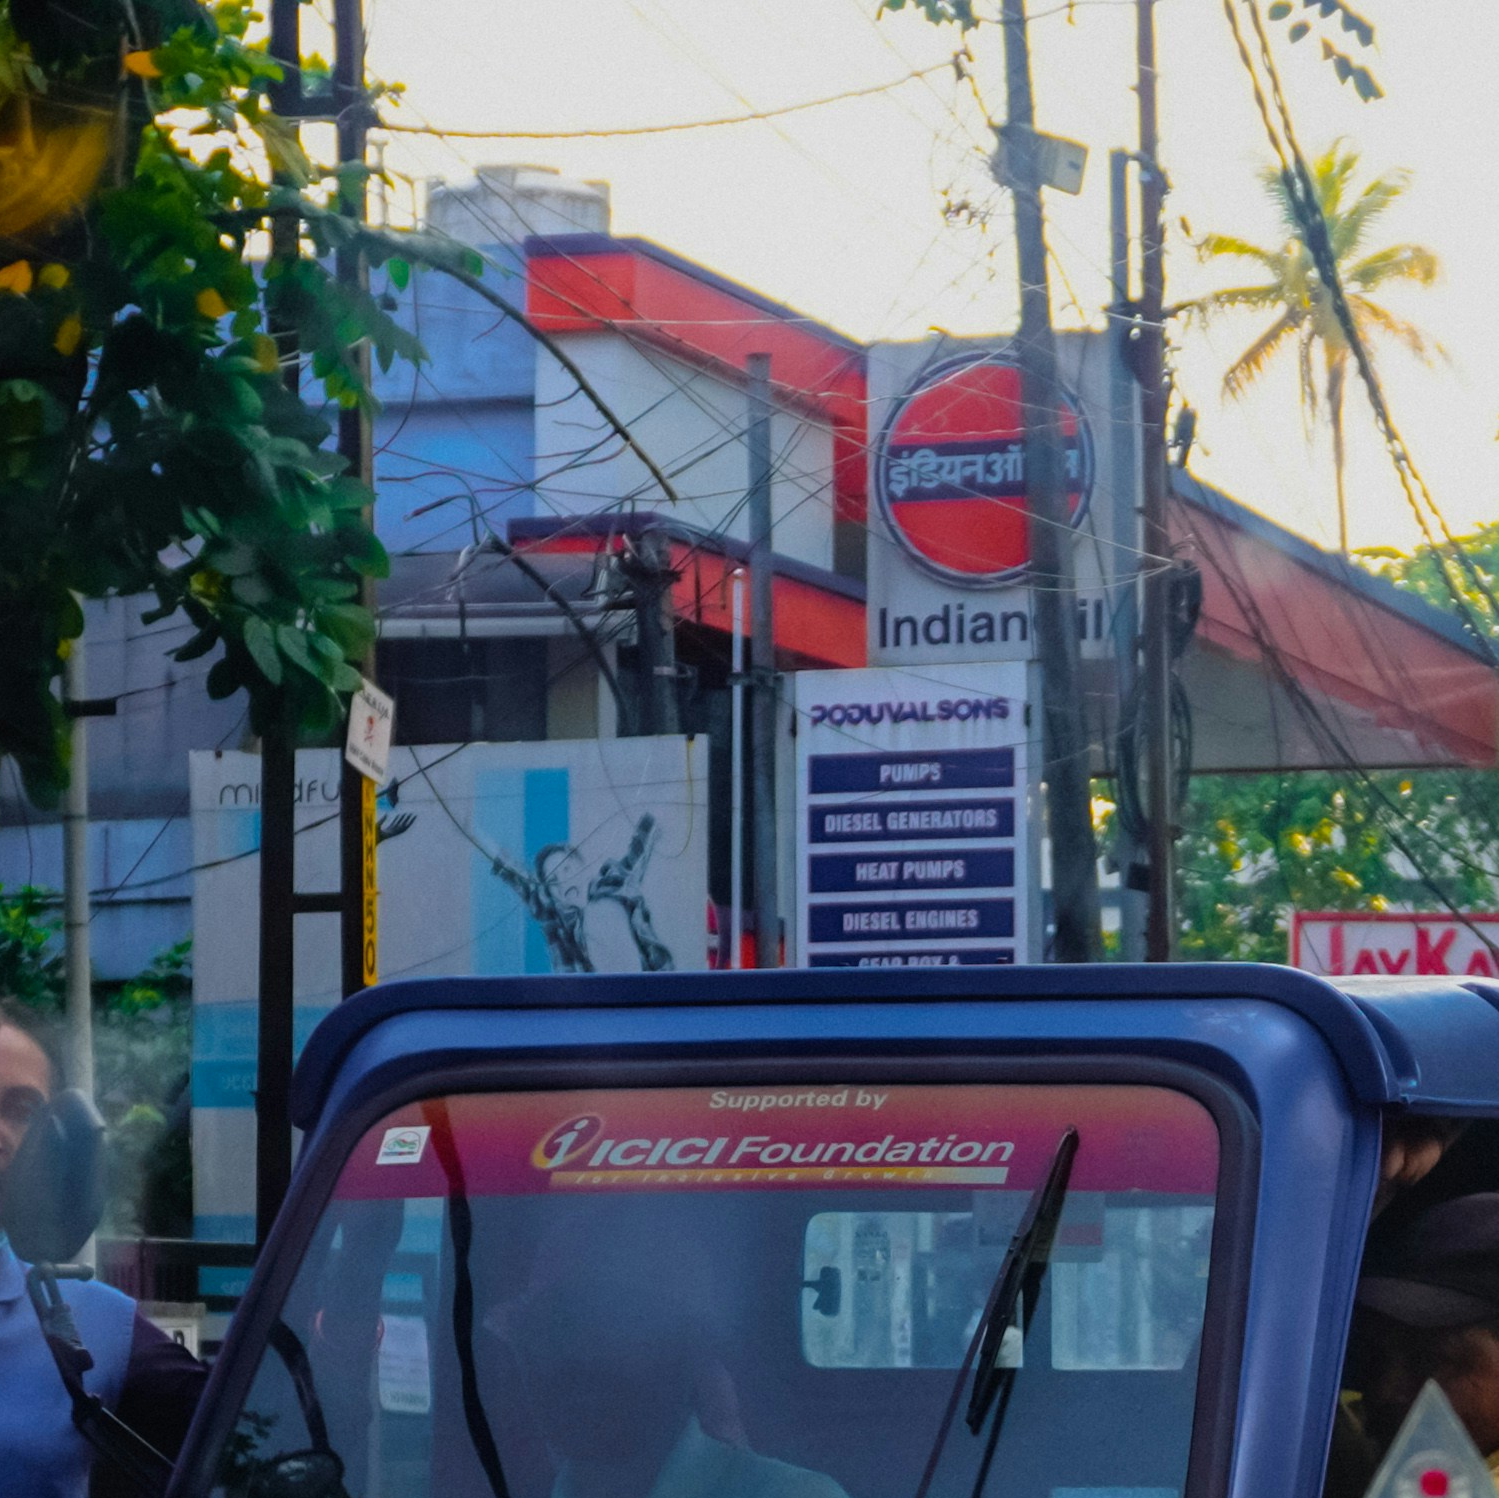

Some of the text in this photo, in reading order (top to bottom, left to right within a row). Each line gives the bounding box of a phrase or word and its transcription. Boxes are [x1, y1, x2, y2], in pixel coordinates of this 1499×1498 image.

[879, 600, 1103, 649] Indianil
[879, 762, 942, 783] PUMPS
[824, 809, 998, 834] DIESEL GENERATORS
[855, 859, 966, 882] HEAT PUMPS
[842, 909, 979, 933] DIESEL ENGINES
[709, 1090, 889, 1113] Supported by
[589, 1137, 729, 1167] ICICI
[730, 1133, 1016, 1165] Foundation
[642, 1169, 797, 1184] Inclusive
